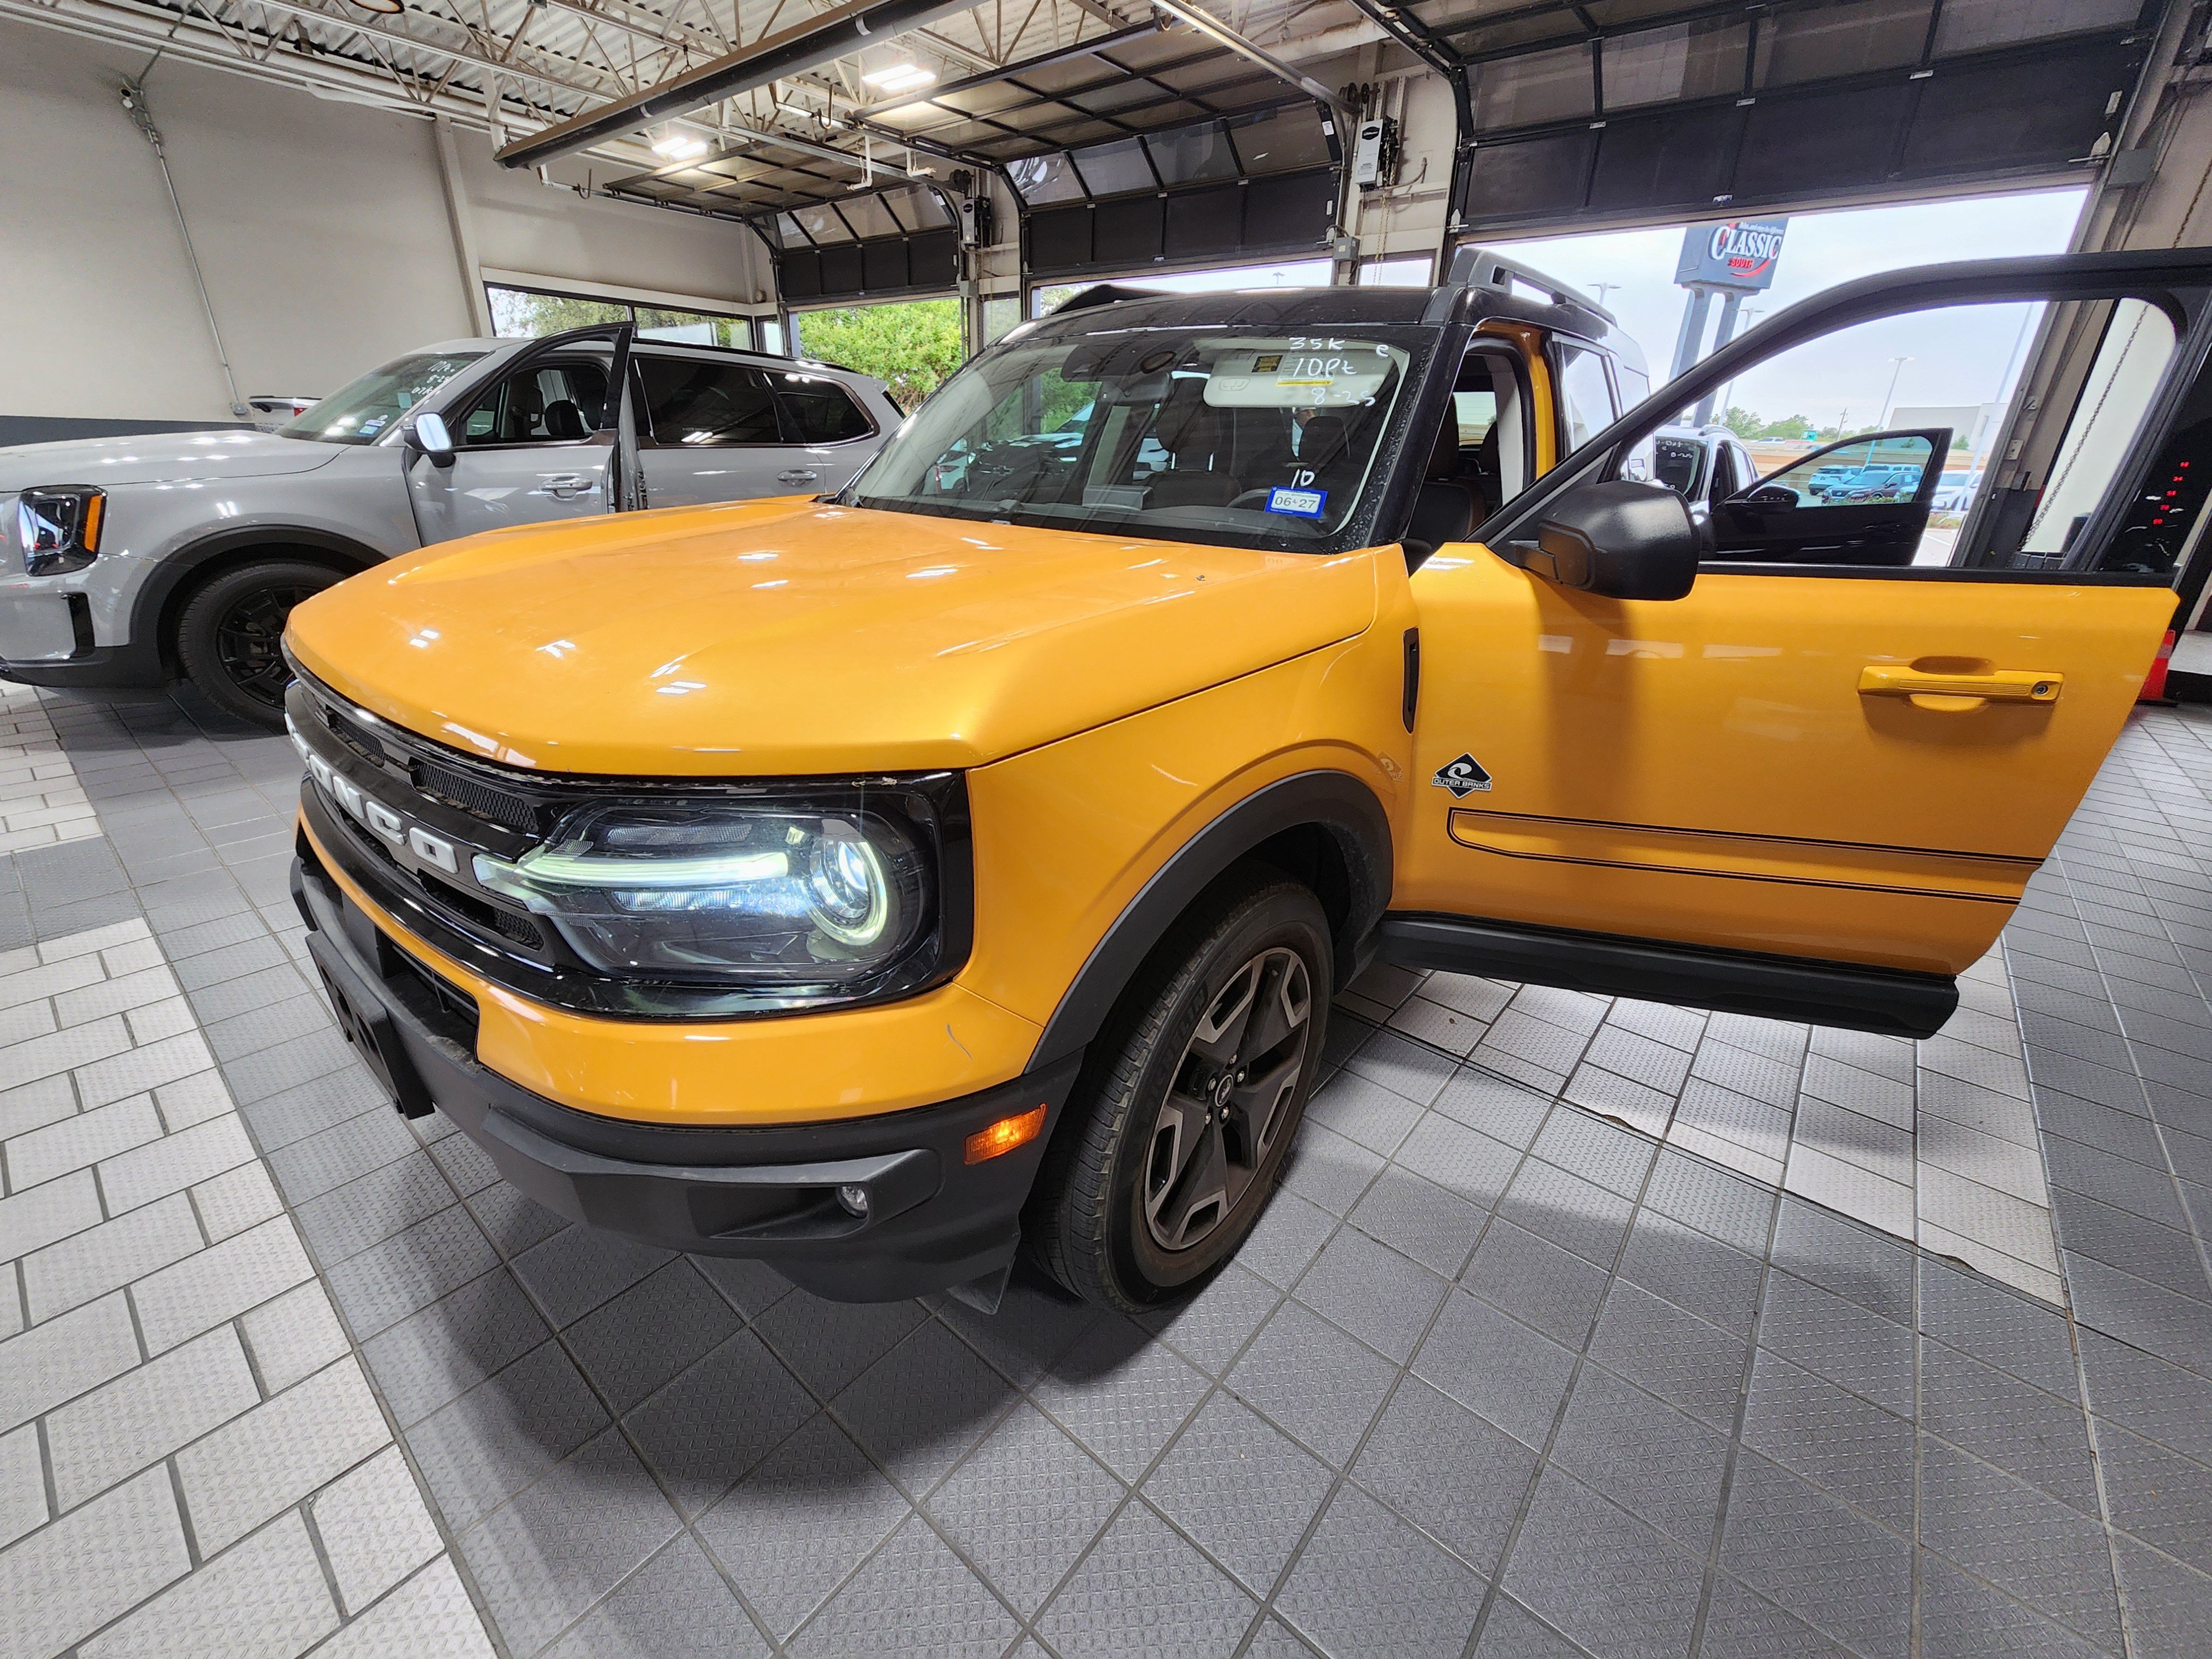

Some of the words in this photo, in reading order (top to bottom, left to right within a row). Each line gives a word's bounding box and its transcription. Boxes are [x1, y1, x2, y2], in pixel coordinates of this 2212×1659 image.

[1710, 226, 1782, 260] CLASSIC
[1730, 257, 1754, 268] SOUTH
[1291, 468, 1316, 489] 10
[1275, 496, 1292, 507] 06
[1298, 499, 1317, 509] 27
[1462, 781, 1490, 789] BANKS
